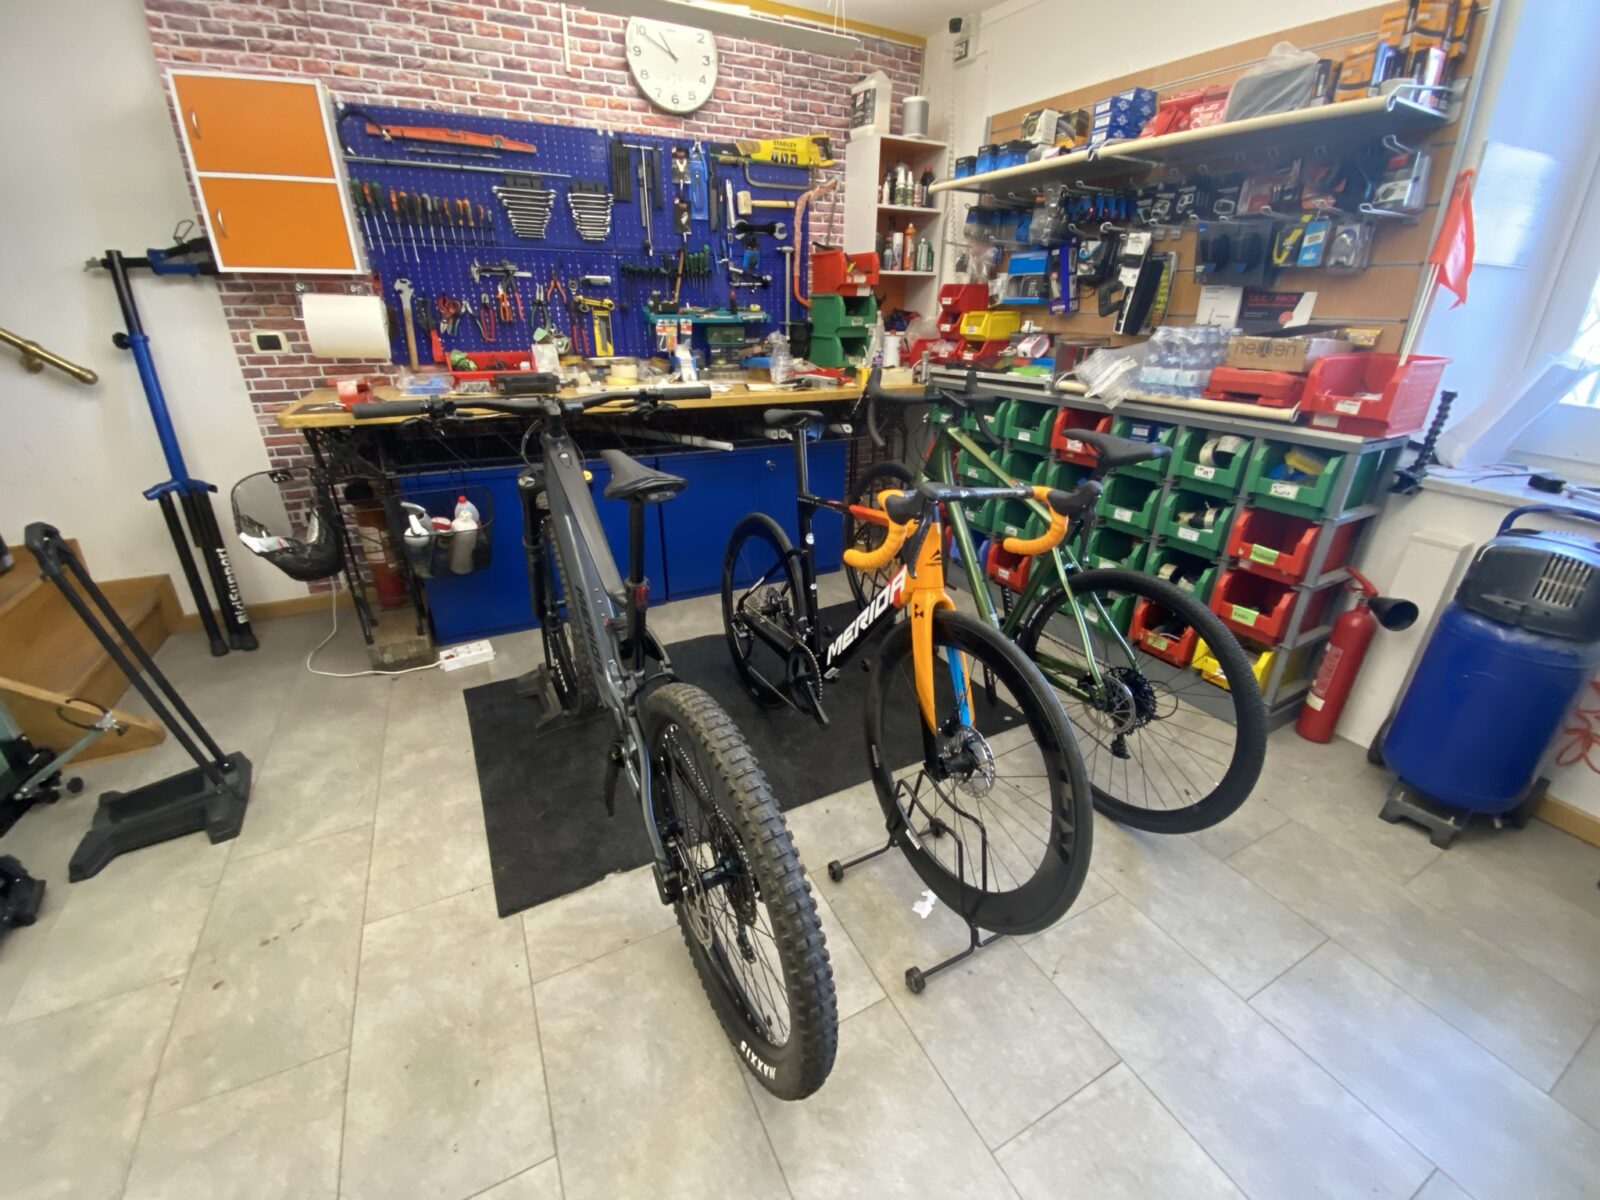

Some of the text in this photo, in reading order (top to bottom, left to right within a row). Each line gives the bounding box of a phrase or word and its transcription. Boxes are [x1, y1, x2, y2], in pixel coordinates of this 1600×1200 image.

[635, 23, 646, 36] 10
[696, 32, 705, 44] 2
[632, 45, 642, 57] 9
[702, 55, 711, 67] 3
[640, 69, 649, 80] 8
[698, 75, 707, 84] 4
[655, 87, 663, 98] 7
[688, 91, 696, 101] 5
[671, 94, 680, 105] 6
[772, 140, 797, 148] STANLEY
[826, 564, 907, 666] MERIDA
[575, 585, 604, 676] MERIDA
[740, 1040, 776, 1080] MAXXIS
